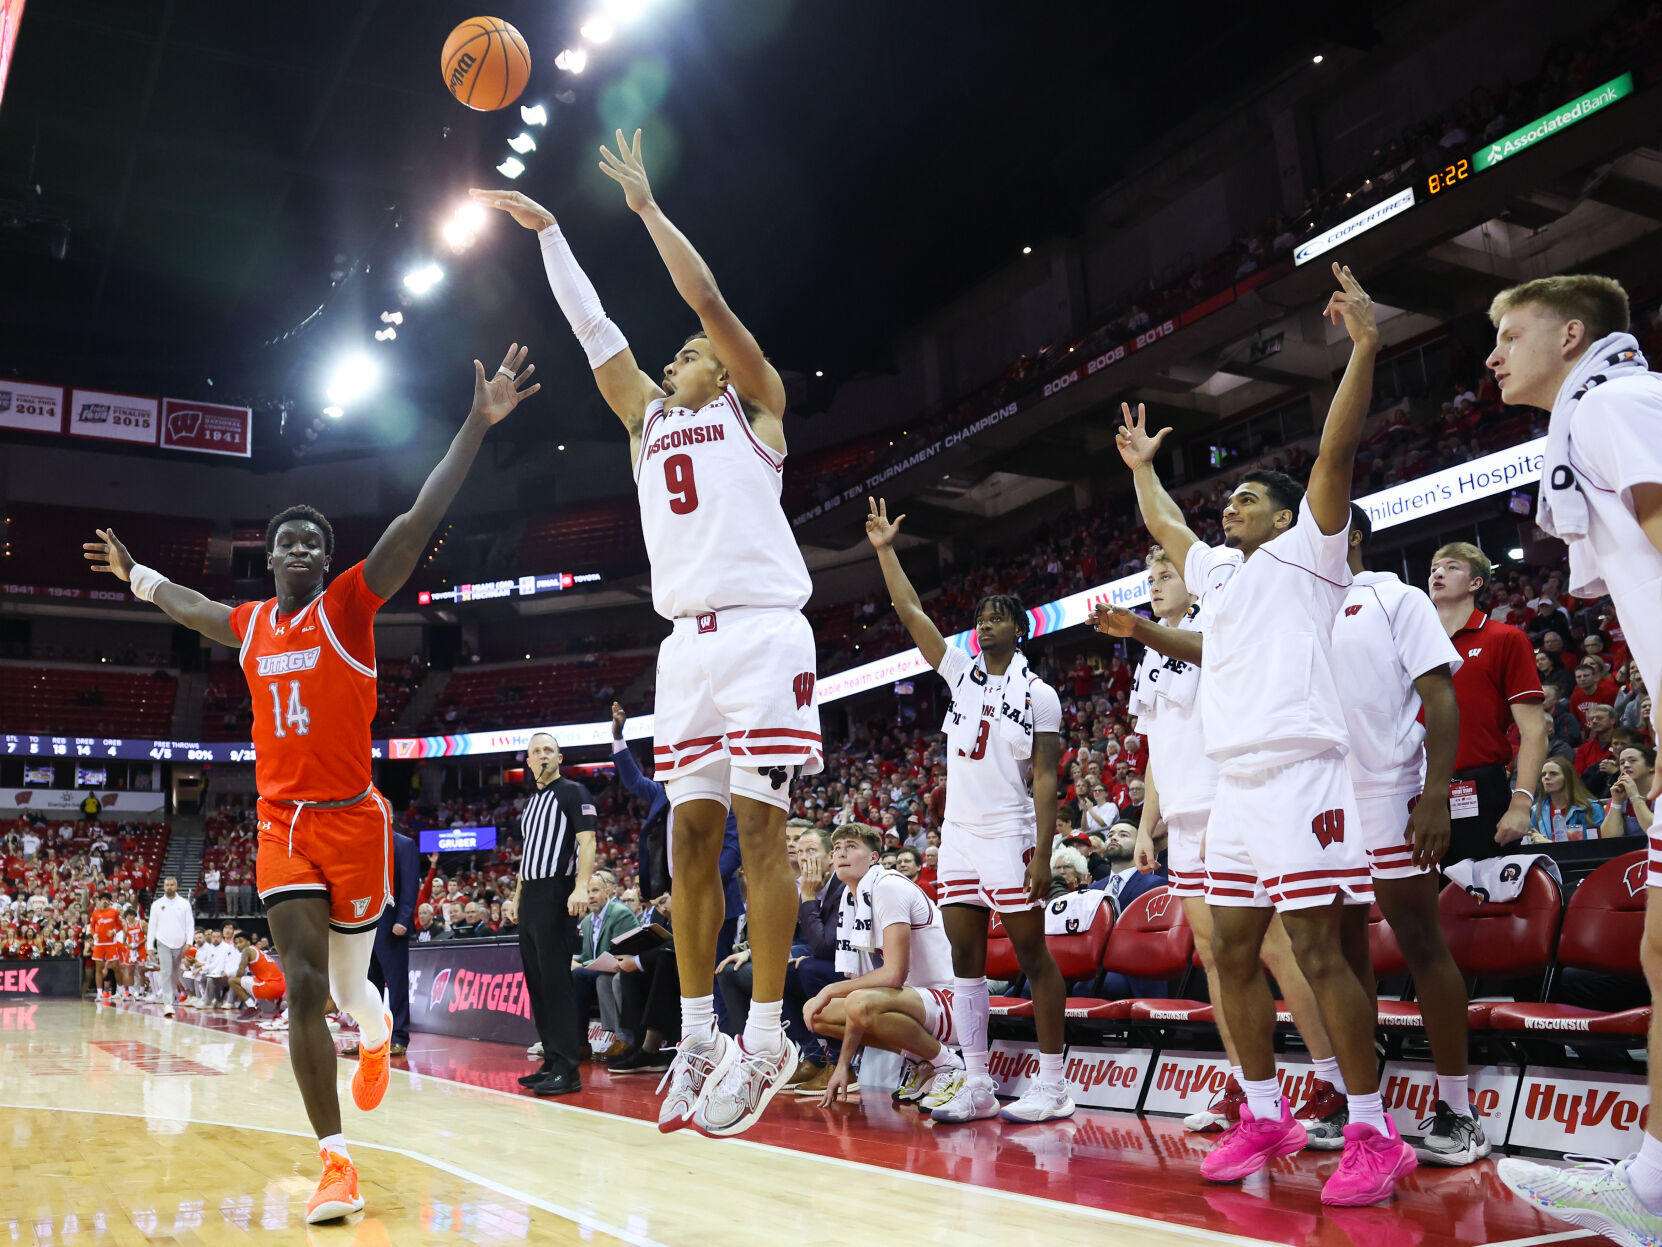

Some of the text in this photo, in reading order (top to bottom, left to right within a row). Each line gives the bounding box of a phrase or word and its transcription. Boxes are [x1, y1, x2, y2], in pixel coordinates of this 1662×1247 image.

[1427, 159, 1468, 194] 8:22
[1136, 320, 1174, 349] 2015
[1087, 345, 1125, 375] 2008
[1043, 370, 1078, 397] 2004
[16, 403, 56, 417] 2014
[113, 416, 151, 429] 2015
[204, 430, 240, 443] 1941
[793, 402, 1018, 527] MEN'S BIG TEN TOURNAMENT CHAMPIONS
[664, 453, 699, 515] 9
[1363, 484, 1452, 524] hildren's
[3, 584, 34, 594] 1941
[48, 587, 80, 598] 1947
[536, 578, 560, 588] FINAL
[573, 573, 601, 583] TOYOTA
[257, 647, 320, 676] UTRGV
[844, 674, 872, 689] health
[875, 666, 895, 680] care
[897, 660, 911, 672] for
[269, 680, 310, 738] 14
[7, 743, 16, 753] 7
[29, 744, 39, 754] 5
[52, 744, 67, 755] 18
[76, 745, 91, 755] 14
[107, 746, 117, 756] 4
[149, 748, 172, 759] 4/5
[187, 749, 213, 760] 80%
[171, 742, 199, 750] THROWS
[438, 837, 477, 849] GRUBER
[1150, 1010, 1189, 1021] WISCONSIN
[1377, 1014, 1423, 1027] WISCONS
[1524, 1017, 1590, 1031] WISCONSIN
[988, 1050, 1041, 1083] HyVe
[1065, 1057, 1139, 1092] HyVee
[1157, 1062, 1234, 1100] HyVe
[1384, 1075, 1500, 1121] Hye
[1525, 1083, 1650, 1135] HyVe
